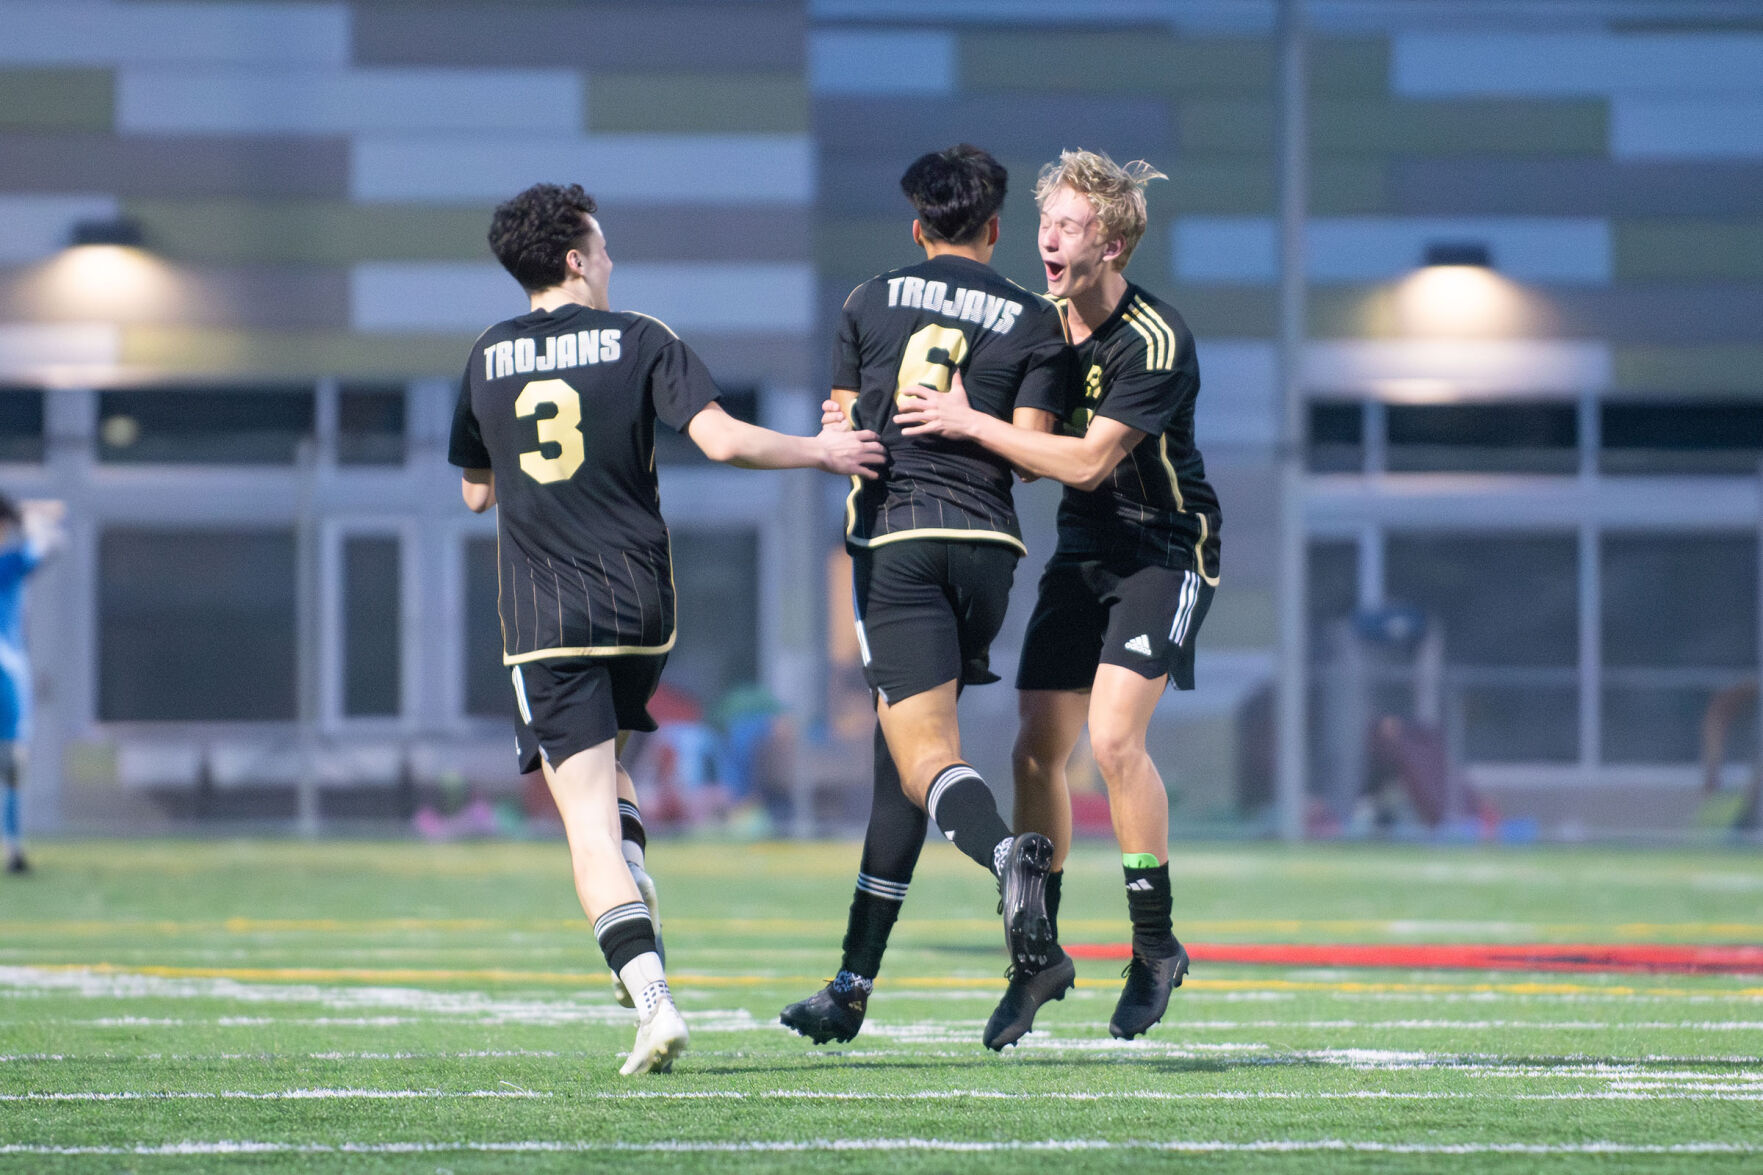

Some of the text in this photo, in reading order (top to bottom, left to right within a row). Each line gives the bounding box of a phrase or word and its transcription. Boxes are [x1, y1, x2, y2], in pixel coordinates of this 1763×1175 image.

[483, 328, 621, 381] TROJANS
[895, 323, 969, 423] 6
[514, 378, 585, 485] 3
